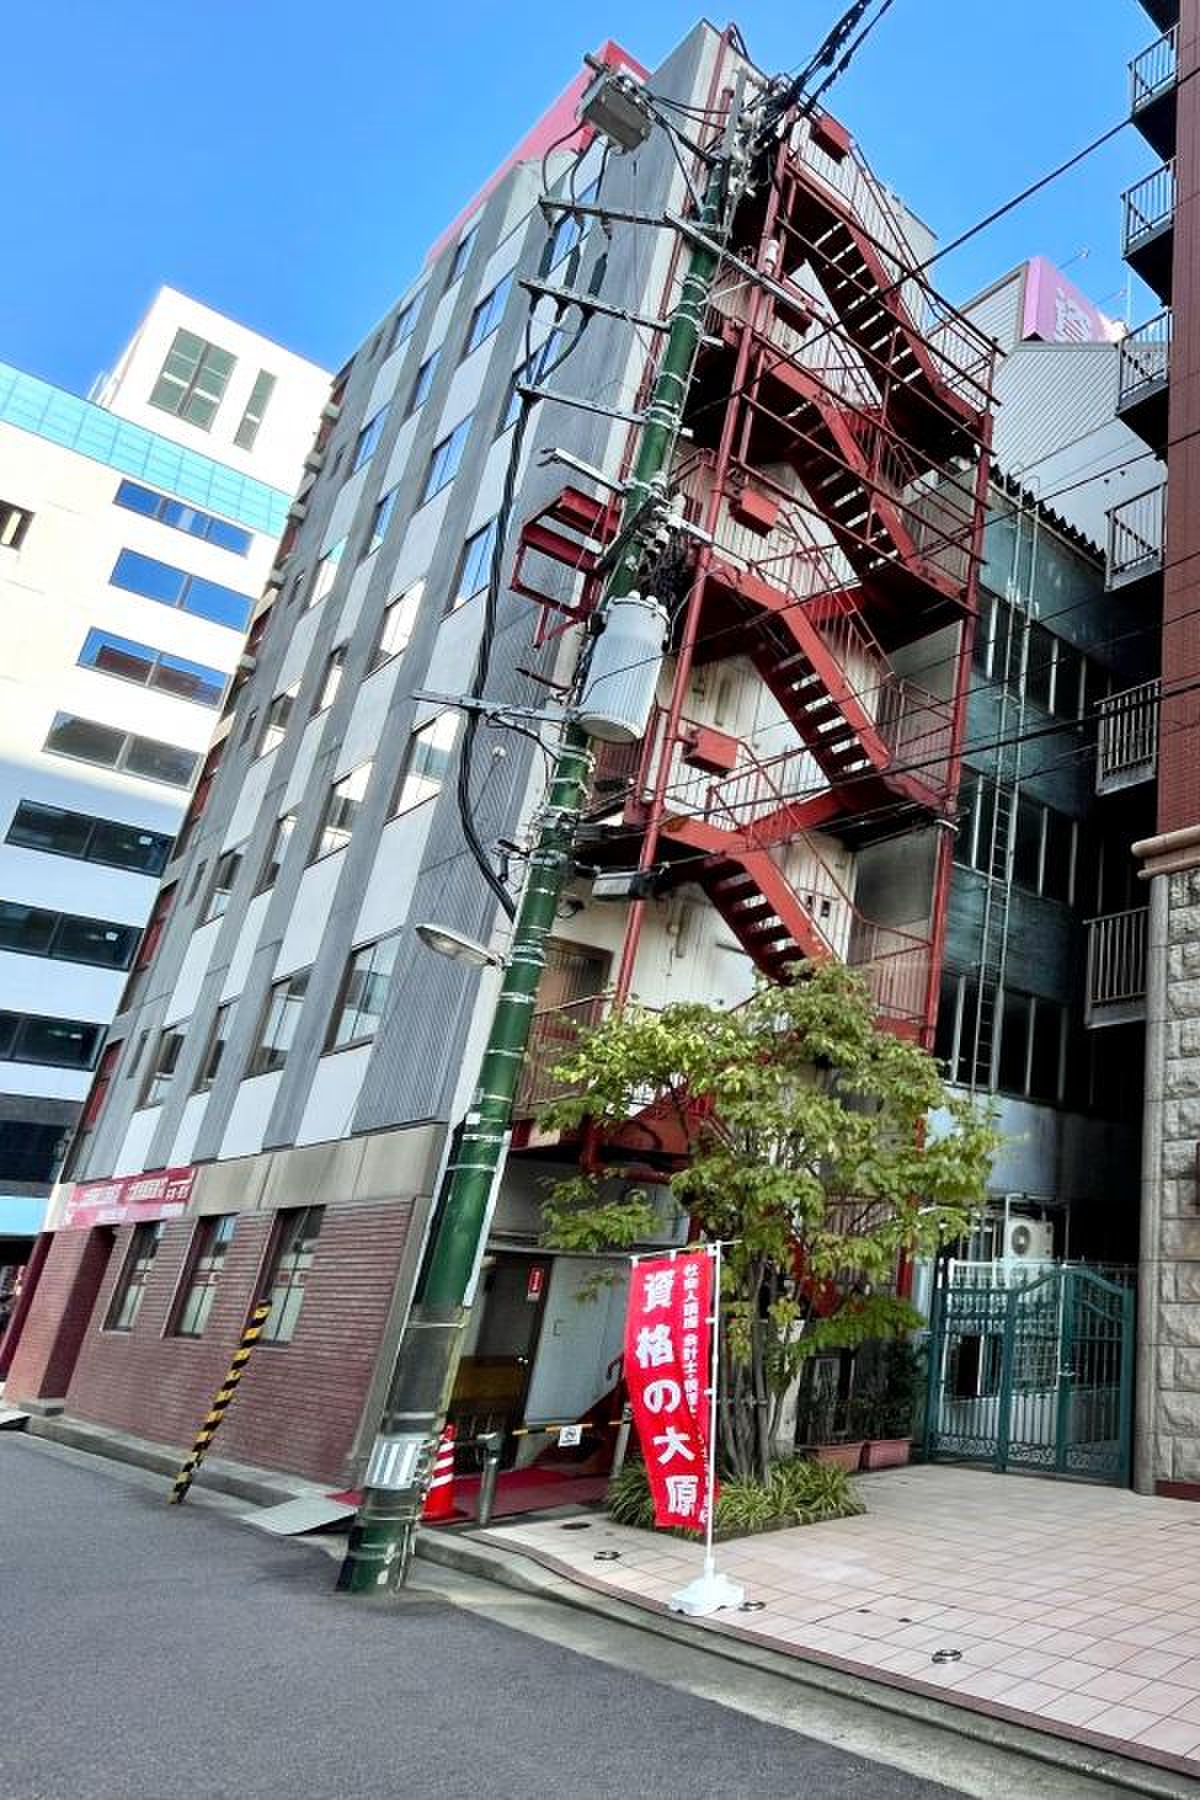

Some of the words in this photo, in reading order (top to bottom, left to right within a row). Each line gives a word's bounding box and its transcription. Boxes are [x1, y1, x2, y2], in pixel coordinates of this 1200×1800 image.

[635, 1269, 699, 1518] 資格の大原
